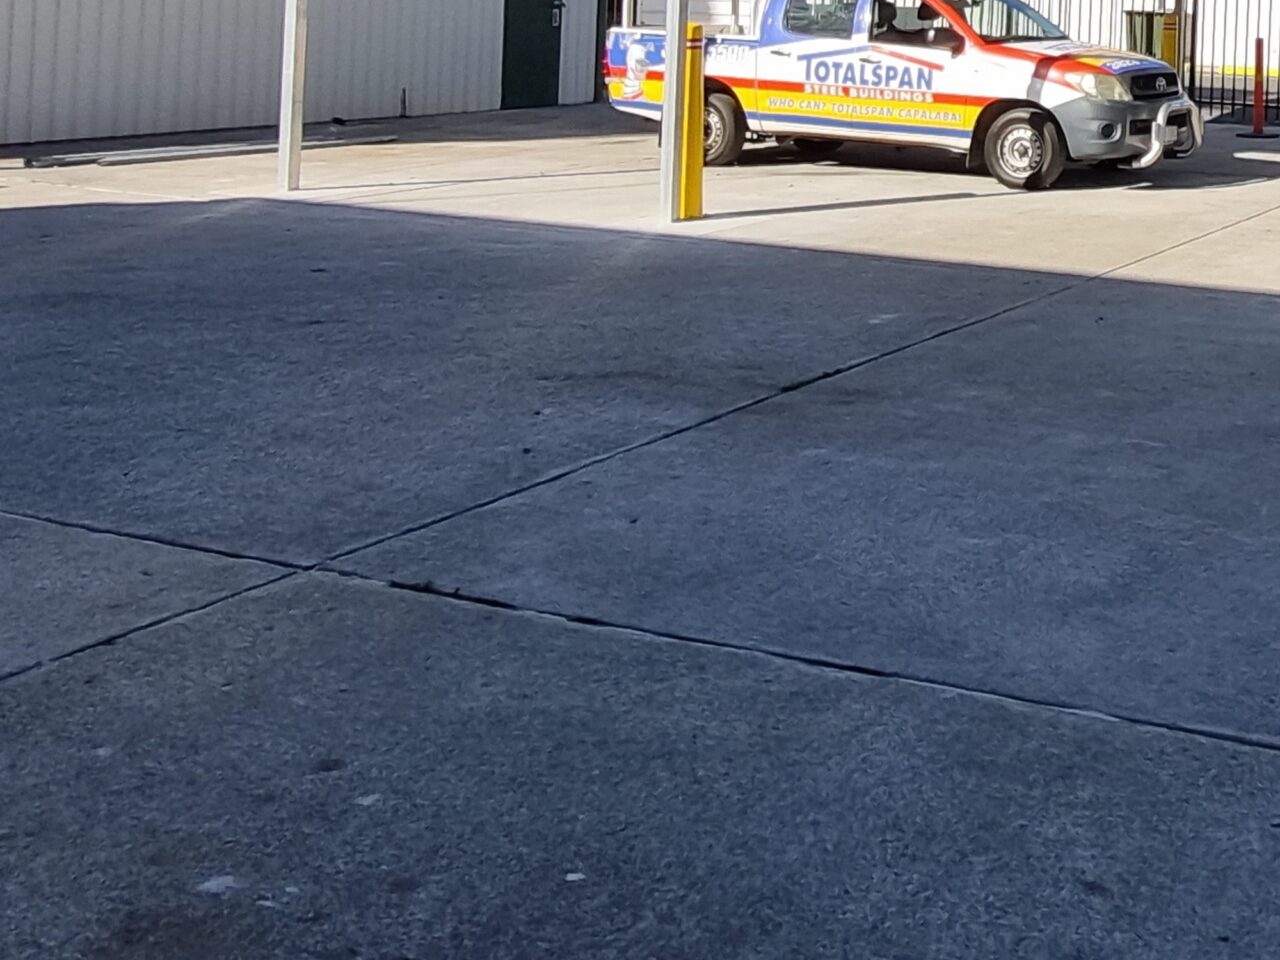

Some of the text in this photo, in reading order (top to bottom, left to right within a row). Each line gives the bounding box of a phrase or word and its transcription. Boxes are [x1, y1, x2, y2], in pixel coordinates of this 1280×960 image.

[800, 57, 934, 91] TOTALSPAN
[803, 83, 935, 104] STEEL BUILDINGS
[767, 97, 795, 109] WHO
[798, 99, 827, 111] CAN?
[831, 103, 894, 117] TOTALSPAN
